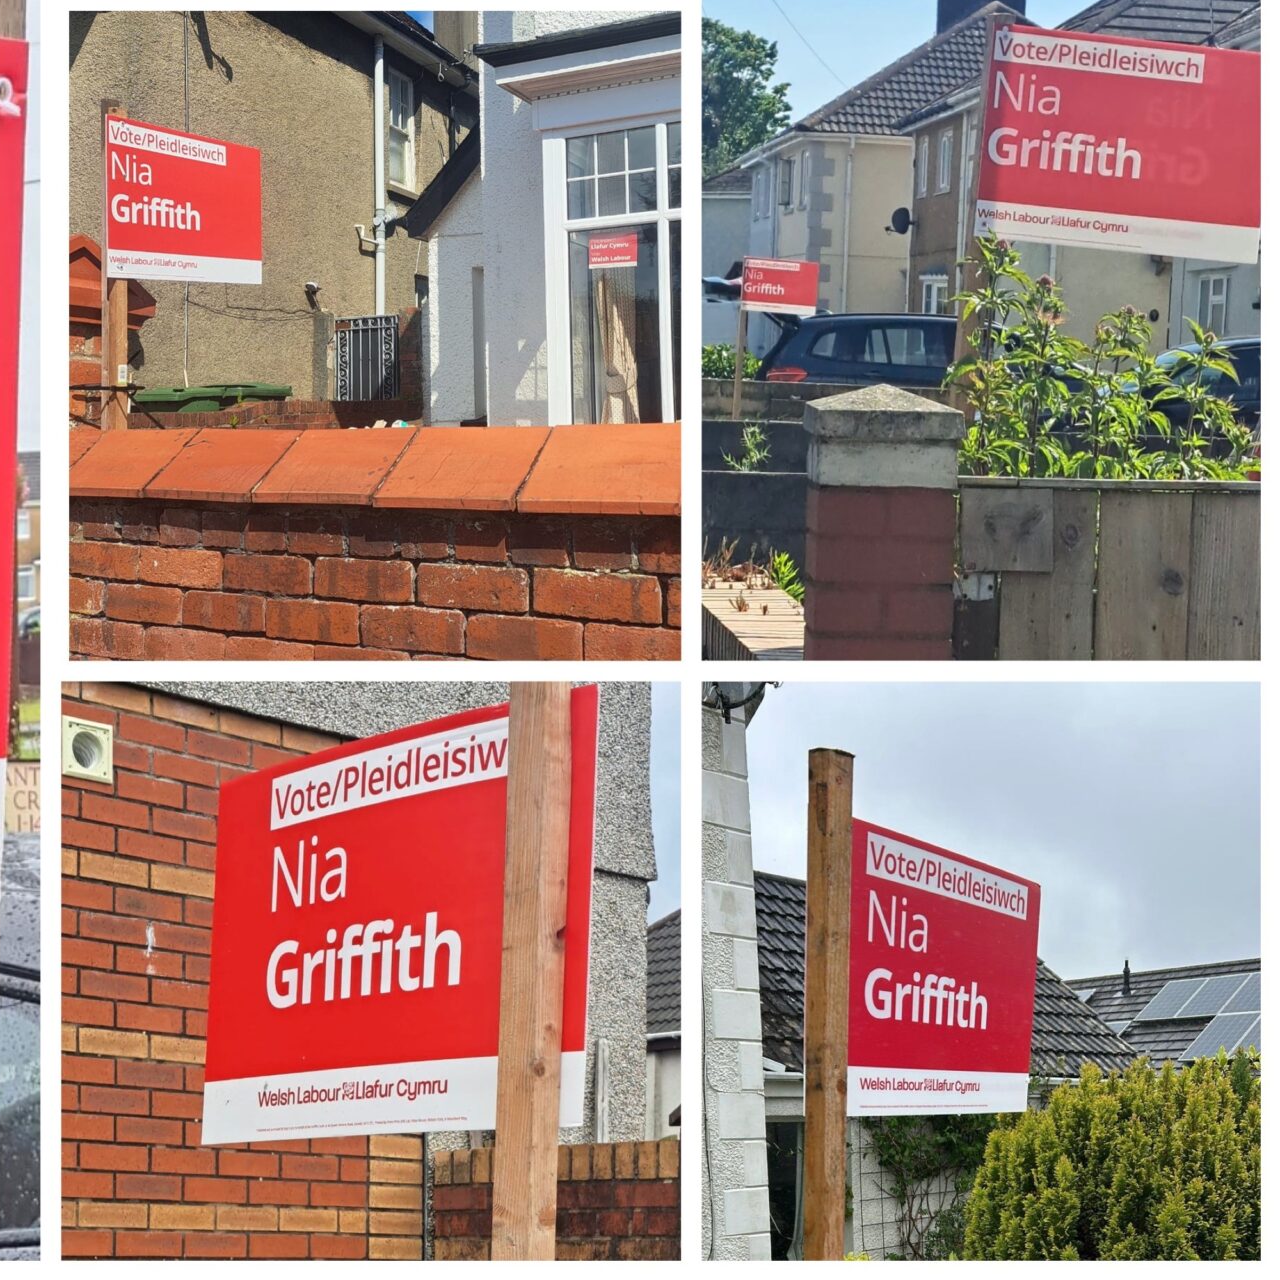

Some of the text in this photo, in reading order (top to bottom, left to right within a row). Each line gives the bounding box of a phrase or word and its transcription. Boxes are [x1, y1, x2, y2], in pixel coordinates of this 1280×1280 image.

[998, 37, 1201, 79] Vote/Pleidleisiwch
[993, 70, 1061, 116] Nia
[110, 124, 225, 163] Vote/Pleidleisiwch
[987, 127, 1142, 180] Griffith
[111, 151, 153, 186] Nia
[111, 193, 201, 232] Griffith
[977, 208, 1012, 221] Welsh
[1012, 211, 1050, 225] Labour
[1061, 215, 1091, 229] Llafur
[1092, 219, 1129, 233] Cymru
[743, 282, 785, 296] Griffith
[744, 269, 764, 280] Nia
[274, 734, 508, 821] Vote/Pleidleisiw
[271, 834, 348, 913] Nia
[869, 840, 1026, 915] Vote/Pleidleisiwch
[867, 889, 929, 954] Nia
[265, 911, 462, 1010] Griffith
[864, 967, 988, 1031] Griffith
[257, 1077, 448, 1108] Welsh Labour Llafur Cymru
[859, 1076, 980, 1095] Welsh Labour Llafur Cymru
